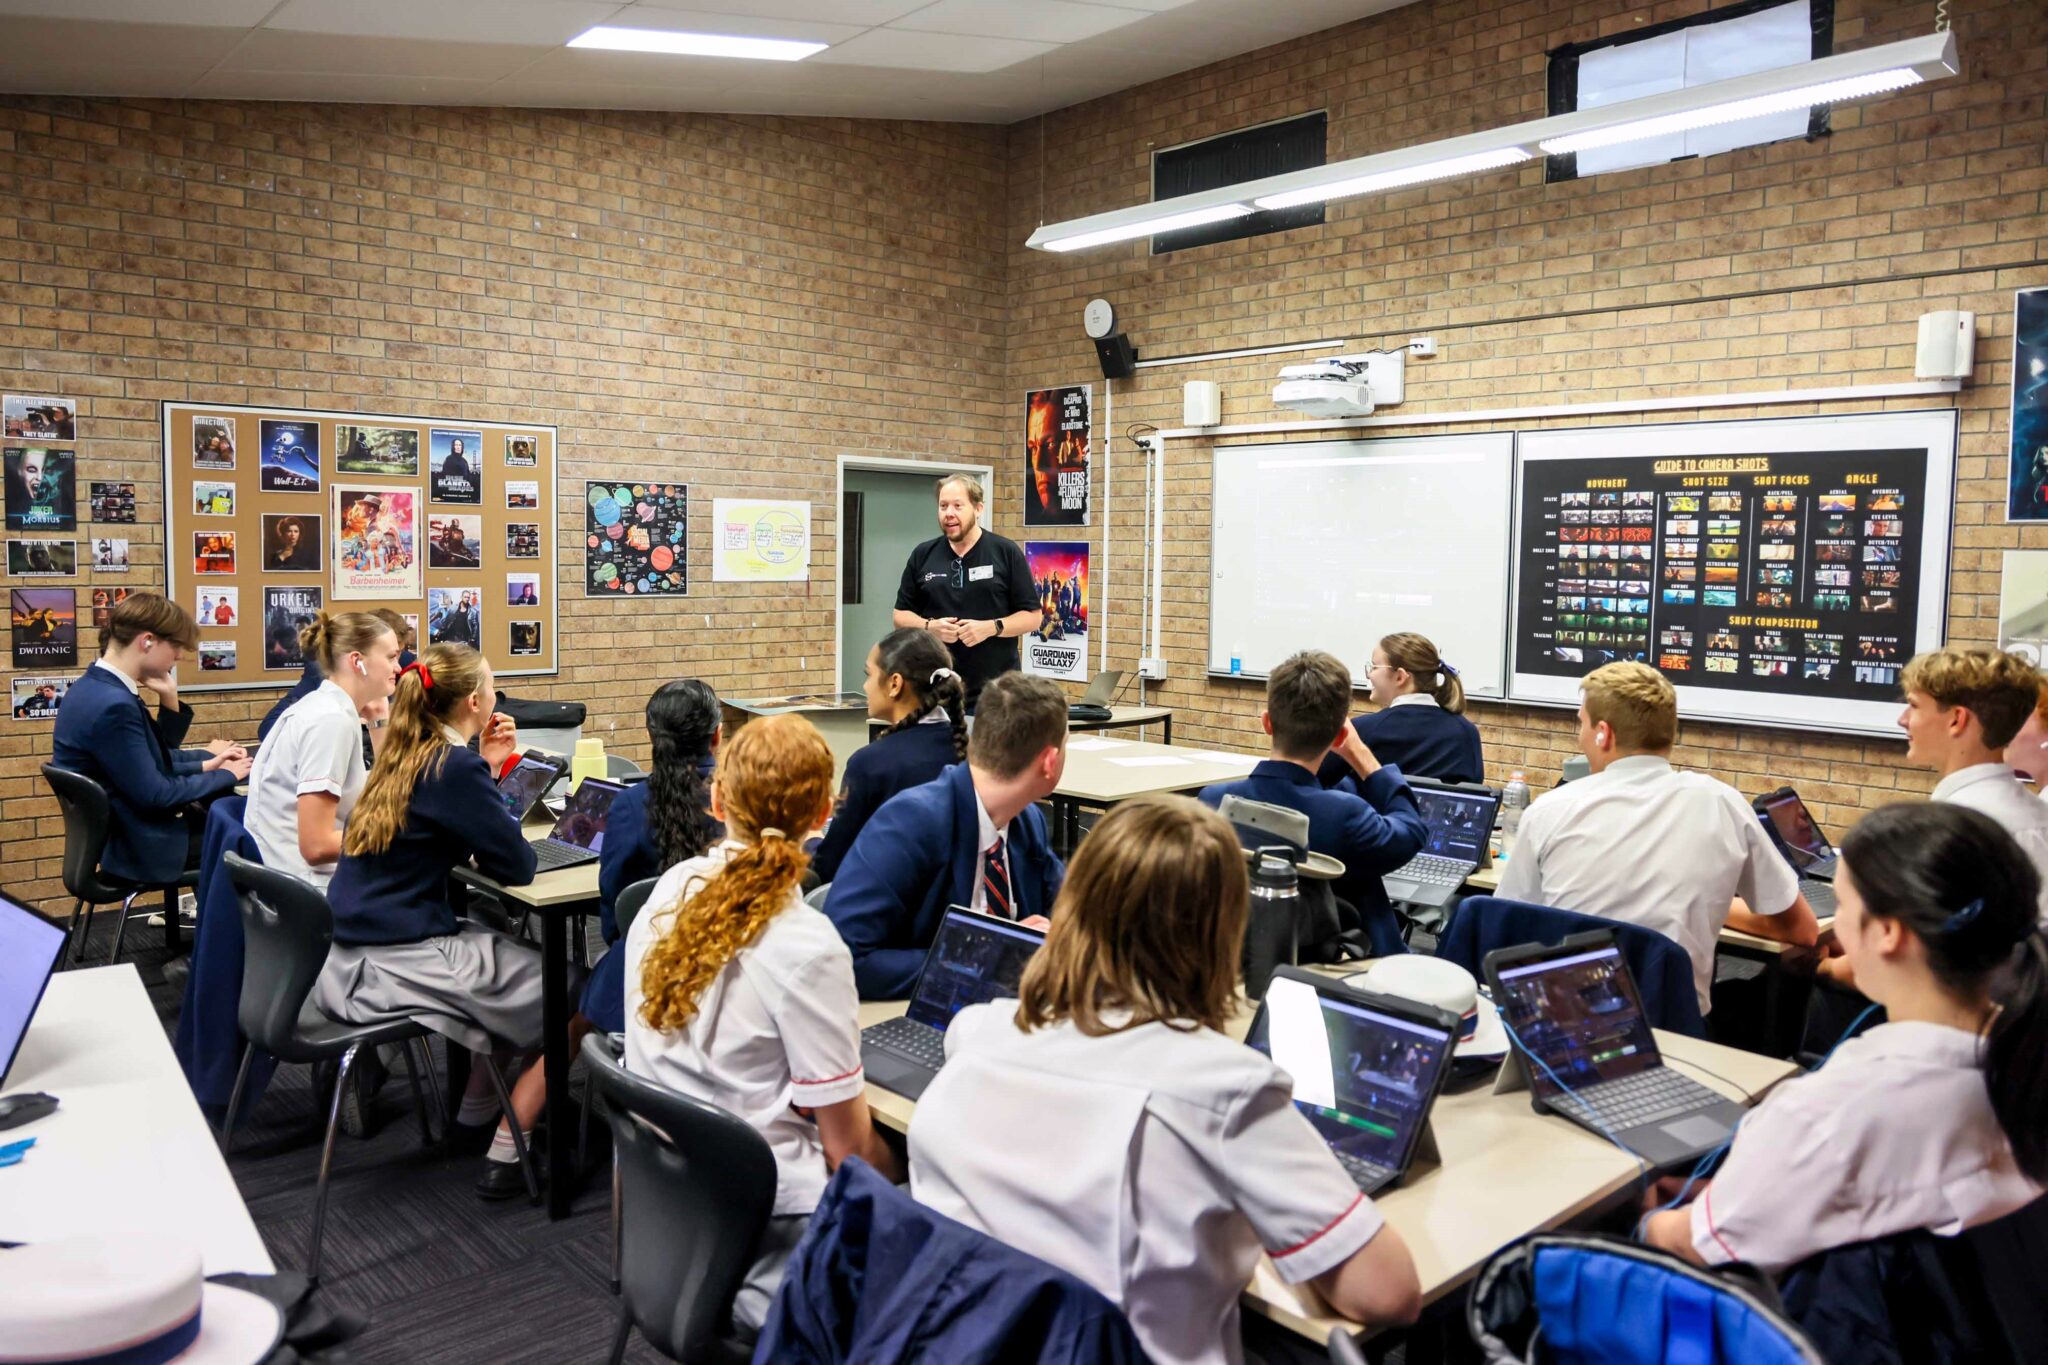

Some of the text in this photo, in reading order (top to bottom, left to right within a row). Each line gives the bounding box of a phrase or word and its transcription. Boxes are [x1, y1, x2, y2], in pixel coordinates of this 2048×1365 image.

[1654, 458, 1768, 471] GUIDE TO CAMERA SHOTS
[1058, 472, 1085, 487] KILLERS
[1587, 479, 1628, 488] MOVEMENT
[1682, 477, 1728, 486] SHOT SIZE
[1754, 475, 1810, 485] SHOT FOCUS
[1846, 474, 1878, 484] ANGLE
[1062, 486, 1084, 498] FLOWER
[1062, 498, 1082, 510] MOON
[350, 576, 405, 584] Barbenheimer
[1729, 616, 1818, 629] SHOT COMPOSITION
[19, 647, 71, 655] DWITANIC
[1033, 649, 1076, 660] GUARDIANS
[1042, 658, 1073, 667] GALAXY
